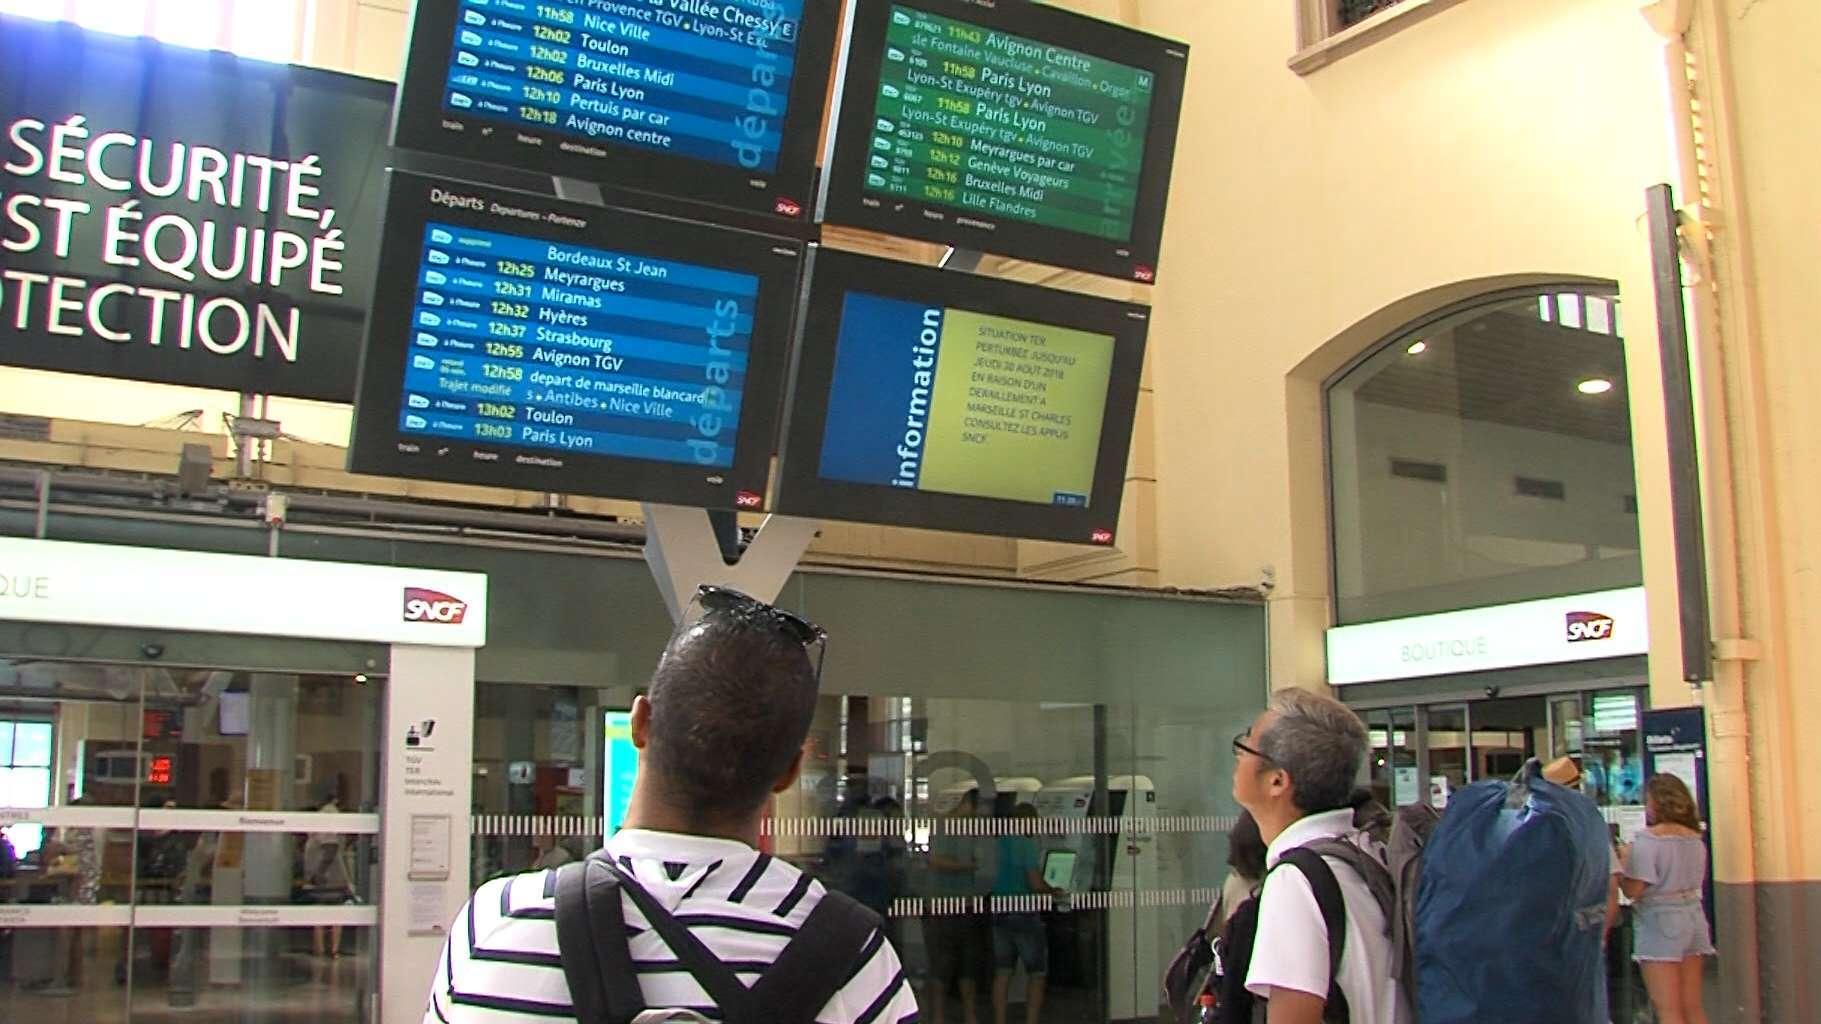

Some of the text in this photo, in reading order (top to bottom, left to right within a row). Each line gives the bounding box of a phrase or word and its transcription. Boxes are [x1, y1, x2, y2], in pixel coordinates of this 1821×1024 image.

[536, 5, 574, 24] 11h58
[584, 13, 616, 33] Nice
[619, 22, 650, 41] Ville
[654, 9, 684, 27] TGV
[693, 19, 744, 42] Lyon-St
[723, 6, 780, 36] Chessy
[533, 25, 629, 56] 12h02 Toulon
[931, 37, 982, 60] Fontaine
[985, 32, 1042, 60] Avignon
[1045, 47, 1092, 72] Centre
[530, 45, 568, 64] 12h02
[576, 53, 641, 80] Bruxelles
[644, 67, 675, 86] Midi
[943, 61, 976, 79] 11h58
[981, 67, 1016, 88] Paris
[1019, 76, 1051, 98] Lyon
[526, 65, 565, 84] 12h06
[573, 73, 608, 94] Paris
[611, 82, 645, 101] Lyon
[907, 68, 1100, 125] Lyon-St Exupéry tgv Avignon TGV
[523, 86, 561, 104] 12h10
[570, 93, 619, 116] Pertuis
[622, 107, 646, 122] par
[648, 112, 671, 126] car
[937, 97, 970, 115] 11h58
[976, 102, 1010, 124] Paris
[1013, 112, 1047, 132] Lyon
[519, 106, 558, 124] 12h18
[566, 114, 624, 136] Avignon
[626, 128, 673, 148] centre
[902, 105, 1095, 159] Lyon-St Exupéry tgv Avignon TGV
[931, 130, 964, 148] 12h10
[970, 139, 1036, 163] Meyrargues
[1037, 156, 1056, 168] par
[1057, 160, 1075, 173] car
[4, 113, 336, 230] SÉCURITÉ,
[965, 173, 1017, 196] Bruxelles
[1019, 184, 1044, 201] Midi
[967, 155, 1011, 176] Genève
[1013, 165, 1069, 189] Voyageurs
[430, 188, 485, 211] Départs
[962, 192, 987, 208] Lille
[989, 197, 1037, 218] Flandres
[0, 193, 346, 295] ST ÉQUIPÉ
[496, 261, 535, 278] 12h25
[544, 267, 625, 292] Meyrargues
[547, 245, 614, 269] Bordeaux
[616, 257, 632, 273] St
[634, 261, 667, 279] Jean
[493, 281, 531, 298] 12h31
[542, 286, 602, 308] Miramas
[0, 269, 300, 362] TECTION
[491, 301, 529, 319] 12h32
[539, 307, 588, 326] Hyères
[488, 321, 527, 338] 12h37
[536, 327, 613, 354] Strasbourg
[978, 326, 1027, 343] SITUATION
[485, 342, 524, 359] 12h55
[533, 347, 591, 367] Avignon
[594, 356, 624, 372] TGV
[973, 357, 1002, 371] JEUDI
[482, 363, 523, 381] 12h58
[530, 371, 571, 387] depart
[575, 376, 591, 389] de
[594, 381, 651, 397] marseille
[686, 298, 739, 466] départs
[972, 371, 1047, 392] EN RAISON D'UN
[440, 377, 469, 393] Trajet
[544, 389, 599, 408] Antibes
[609, 397, 640, 414] Nice
[642, 401, 674, 418] Ville
[477, 403, 516, 419] 13h02
[525, 406, 574, 425] Toulon
[891, 308, 941, 488] information
[967, 402, 1073, 426] MARSEILLE ST CHARLES
[474, 423, 513, 438] 13h03
[522, 427, 556, 444] Paris
[559, 432, 593, 448] Lyon
[963, 417, 1019, 434] CONSULTEZ
[1021, 425, 1038, 437] LES
[1400, 635, 1489, 663] BOUTIQUE
